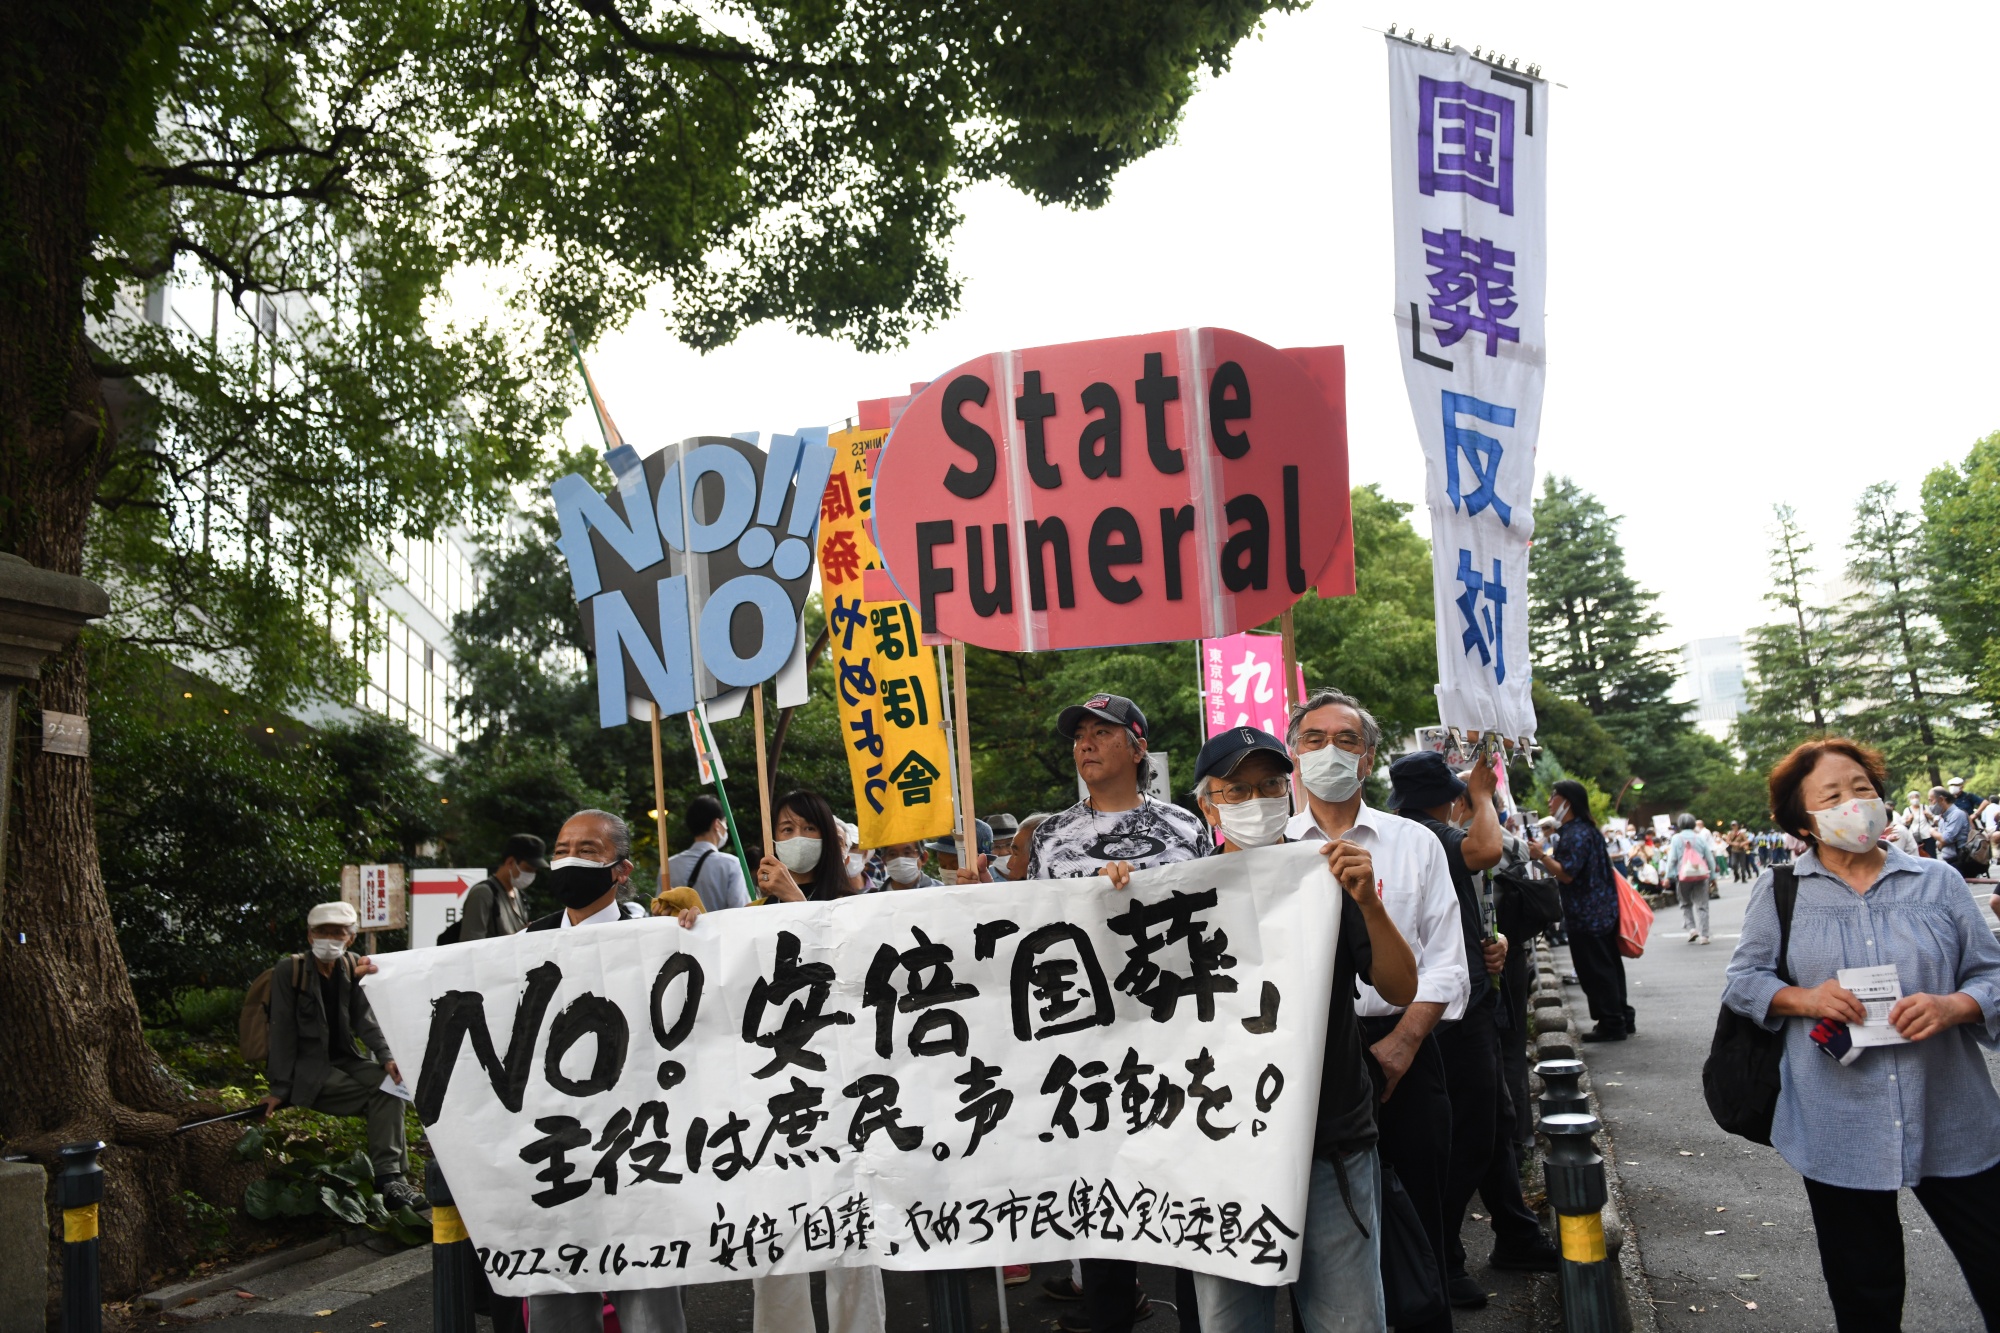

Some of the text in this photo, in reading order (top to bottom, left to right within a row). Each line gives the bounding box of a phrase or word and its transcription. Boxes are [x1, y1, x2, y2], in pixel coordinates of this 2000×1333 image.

[941, 352, 1252, 499] State
[550, 434, 837, 602] NO!!
[915, 465, 1306, 634] Funeral
[593, 574, 798, 729] NO
[1208, 648, 1226, 726] 東京勝手連
